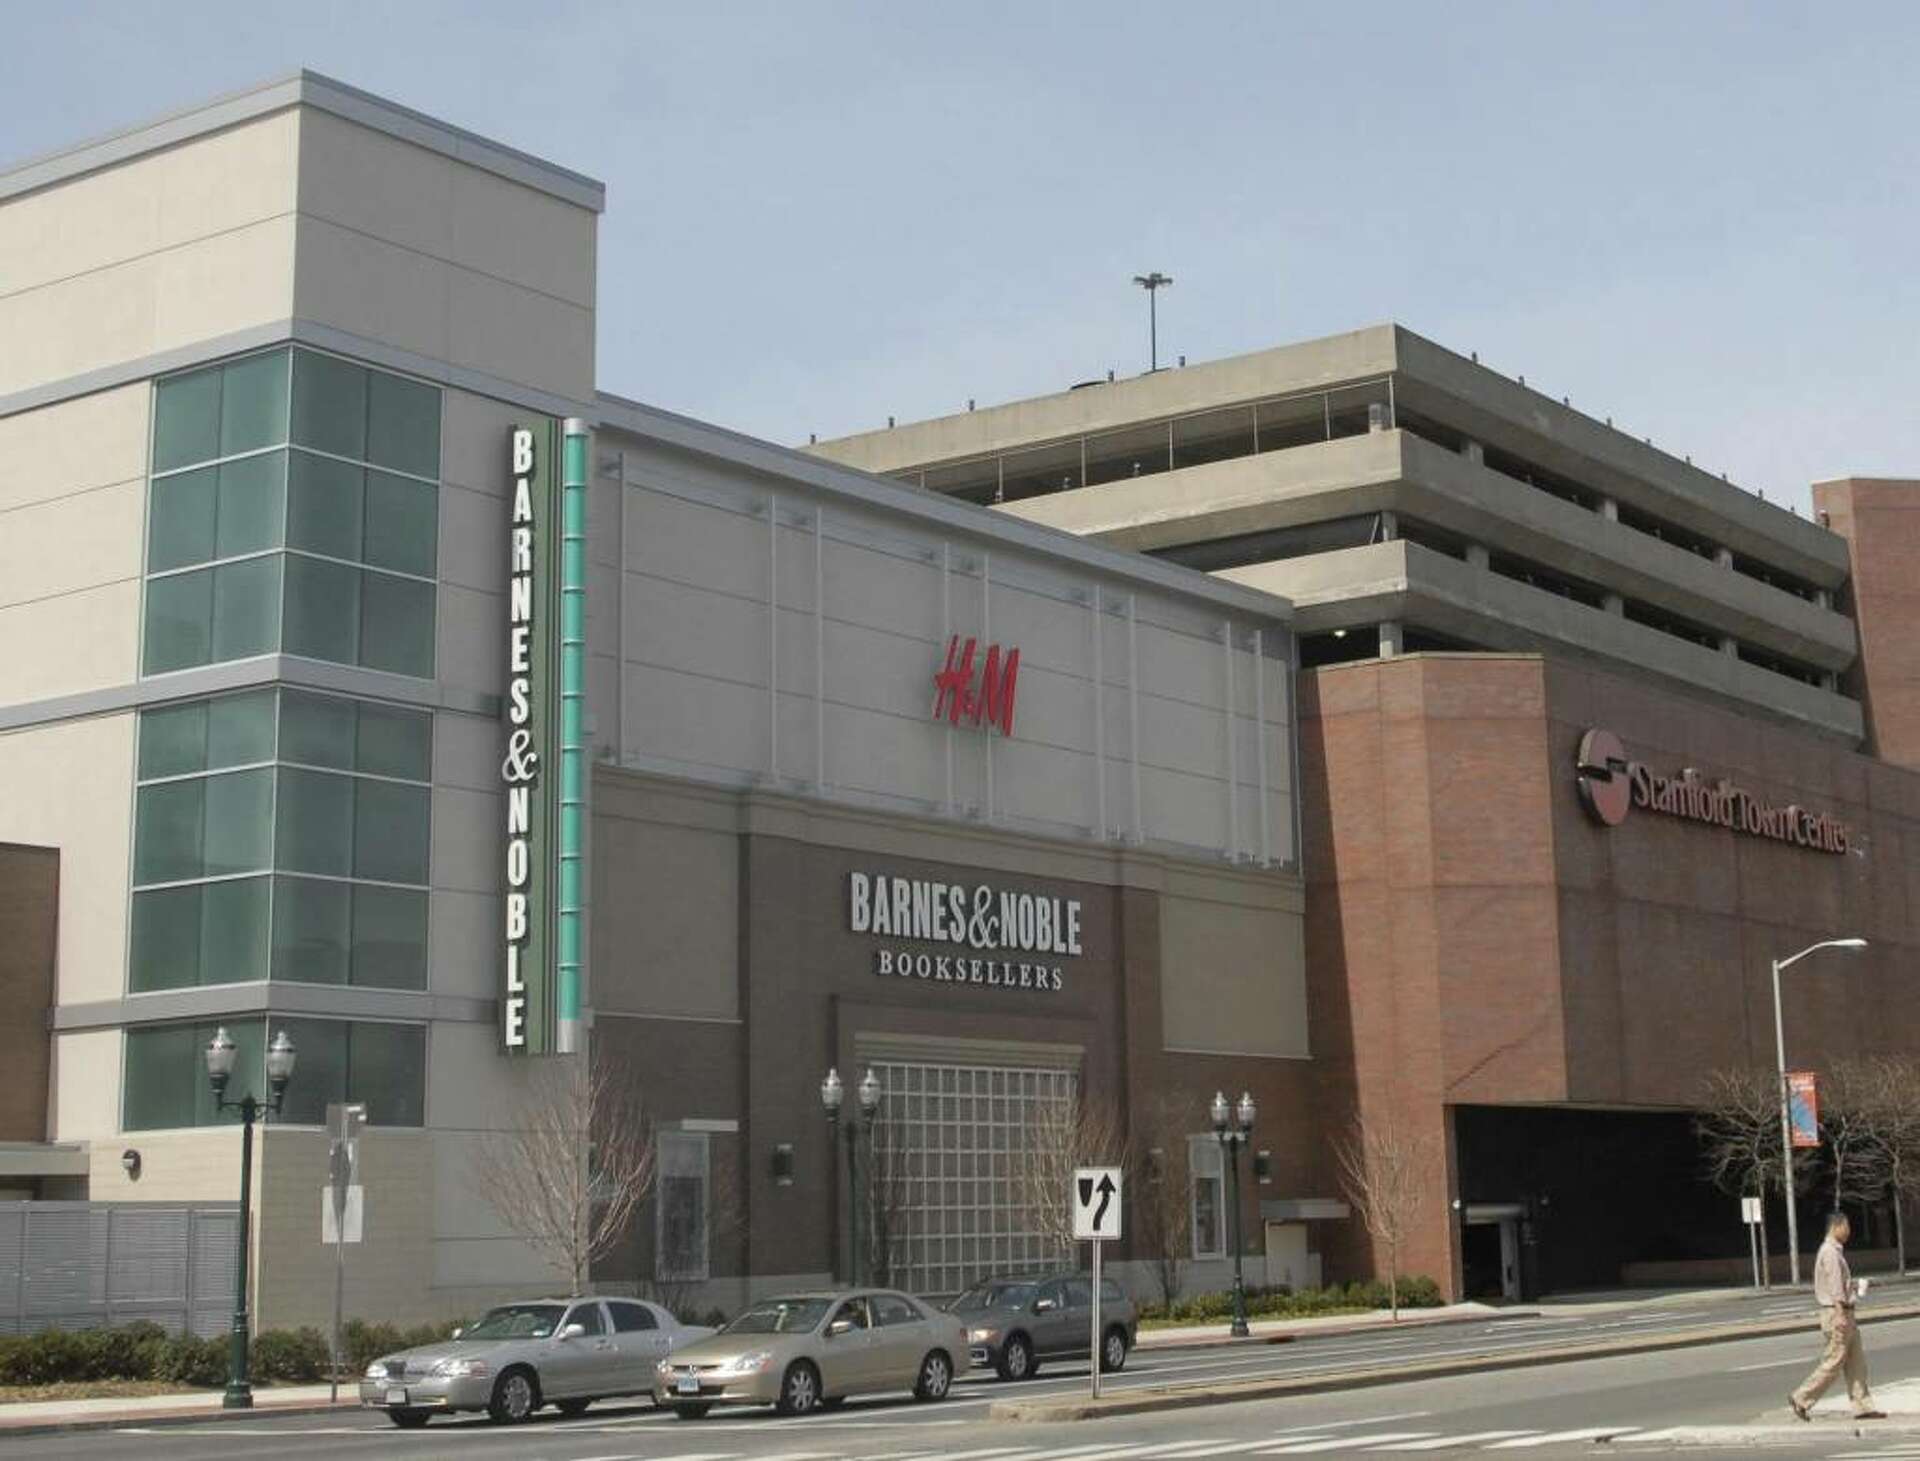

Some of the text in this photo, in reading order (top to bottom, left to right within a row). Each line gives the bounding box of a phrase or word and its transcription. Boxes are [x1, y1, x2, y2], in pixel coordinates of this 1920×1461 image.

[933, 634, 1020, 737] H&M
[1628, 763, 1734, 827] Stamford
[879, 949, 1064, 991] BOOKSELLERS
